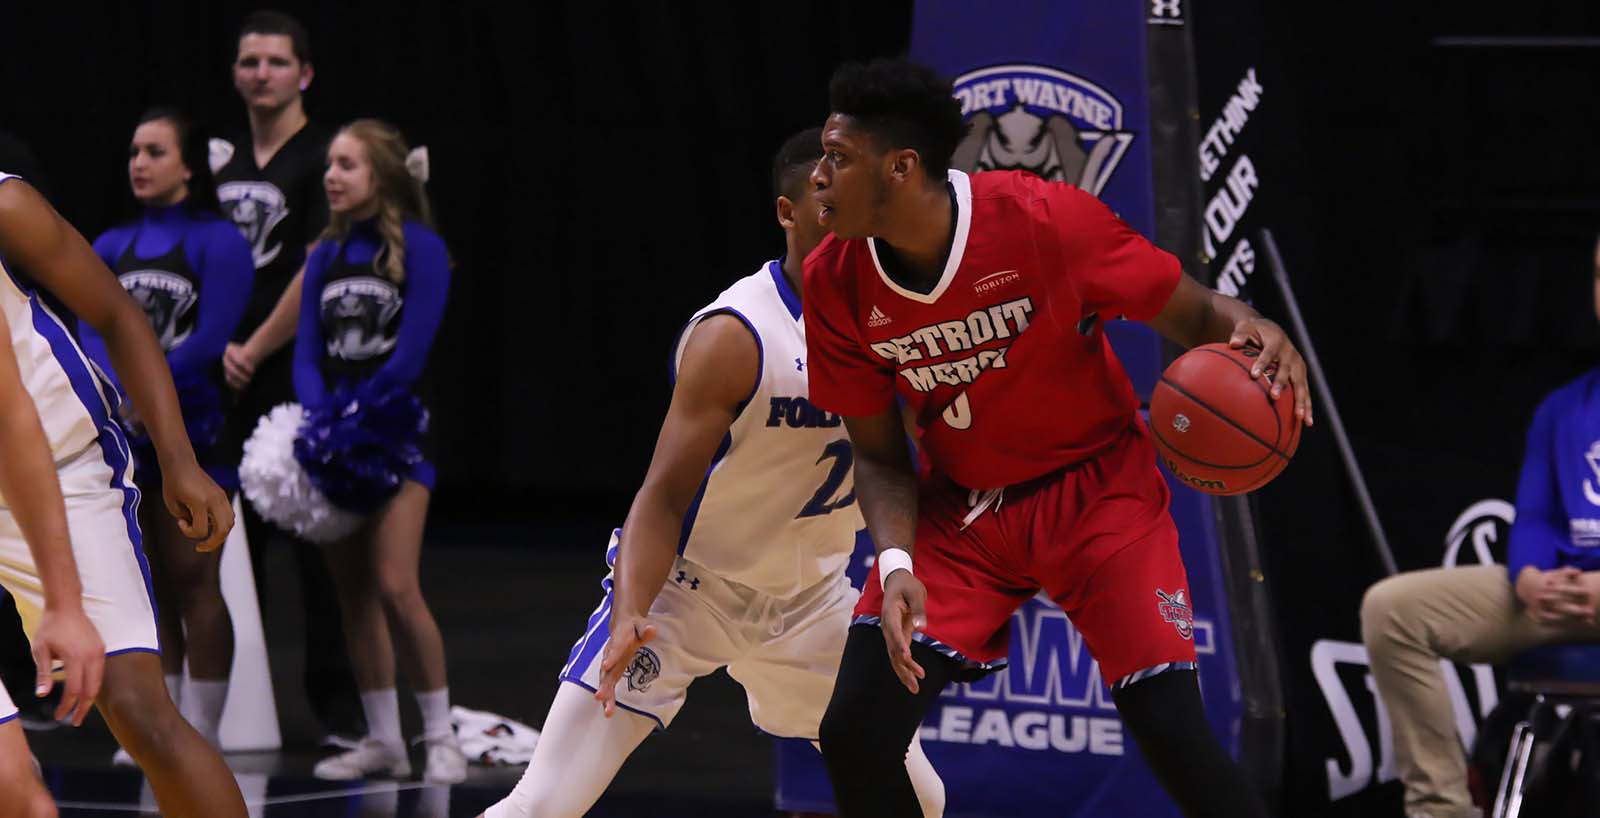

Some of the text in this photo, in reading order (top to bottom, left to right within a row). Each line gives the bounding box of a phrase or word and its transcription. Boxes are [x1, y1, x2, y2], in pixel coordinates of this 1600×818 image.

[952, 78, 1114, 130] ORT WAYNE
[1199, 67, 1263, 181] ETHINK
[974, 272, 1020, 293] HORIZON
[869, 297, 1034, 366] DETROIT
